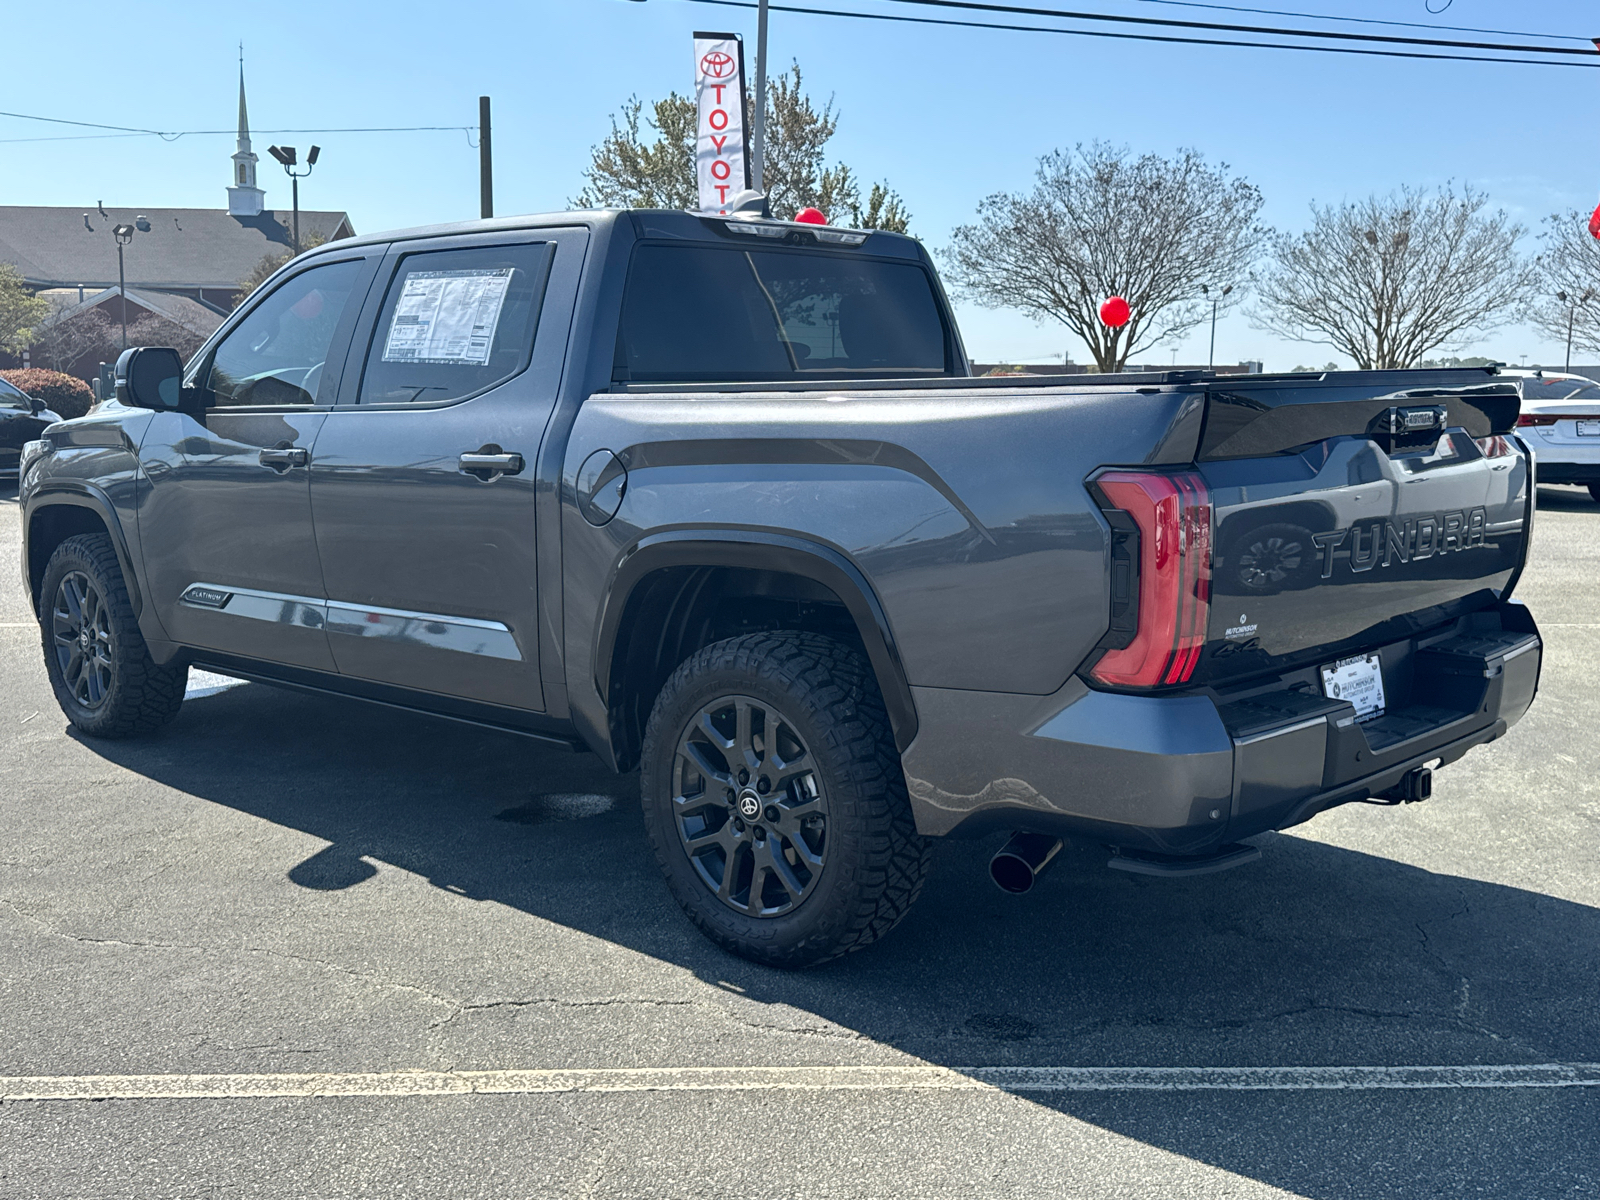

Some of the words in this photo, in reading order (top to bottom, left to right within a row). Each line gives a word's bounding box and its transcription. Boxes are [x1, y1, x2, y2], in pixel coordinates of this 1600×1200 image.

[709, 84, 731, 216] TOYOT
[1311, 505, 1487, 579] TUNDRA
[191, 590, 222, 601] PLATINUM
[1225, 624, 1258, 636] HUTCHINSON
[1342, 675, 1375, 693] HUTCHINSON
